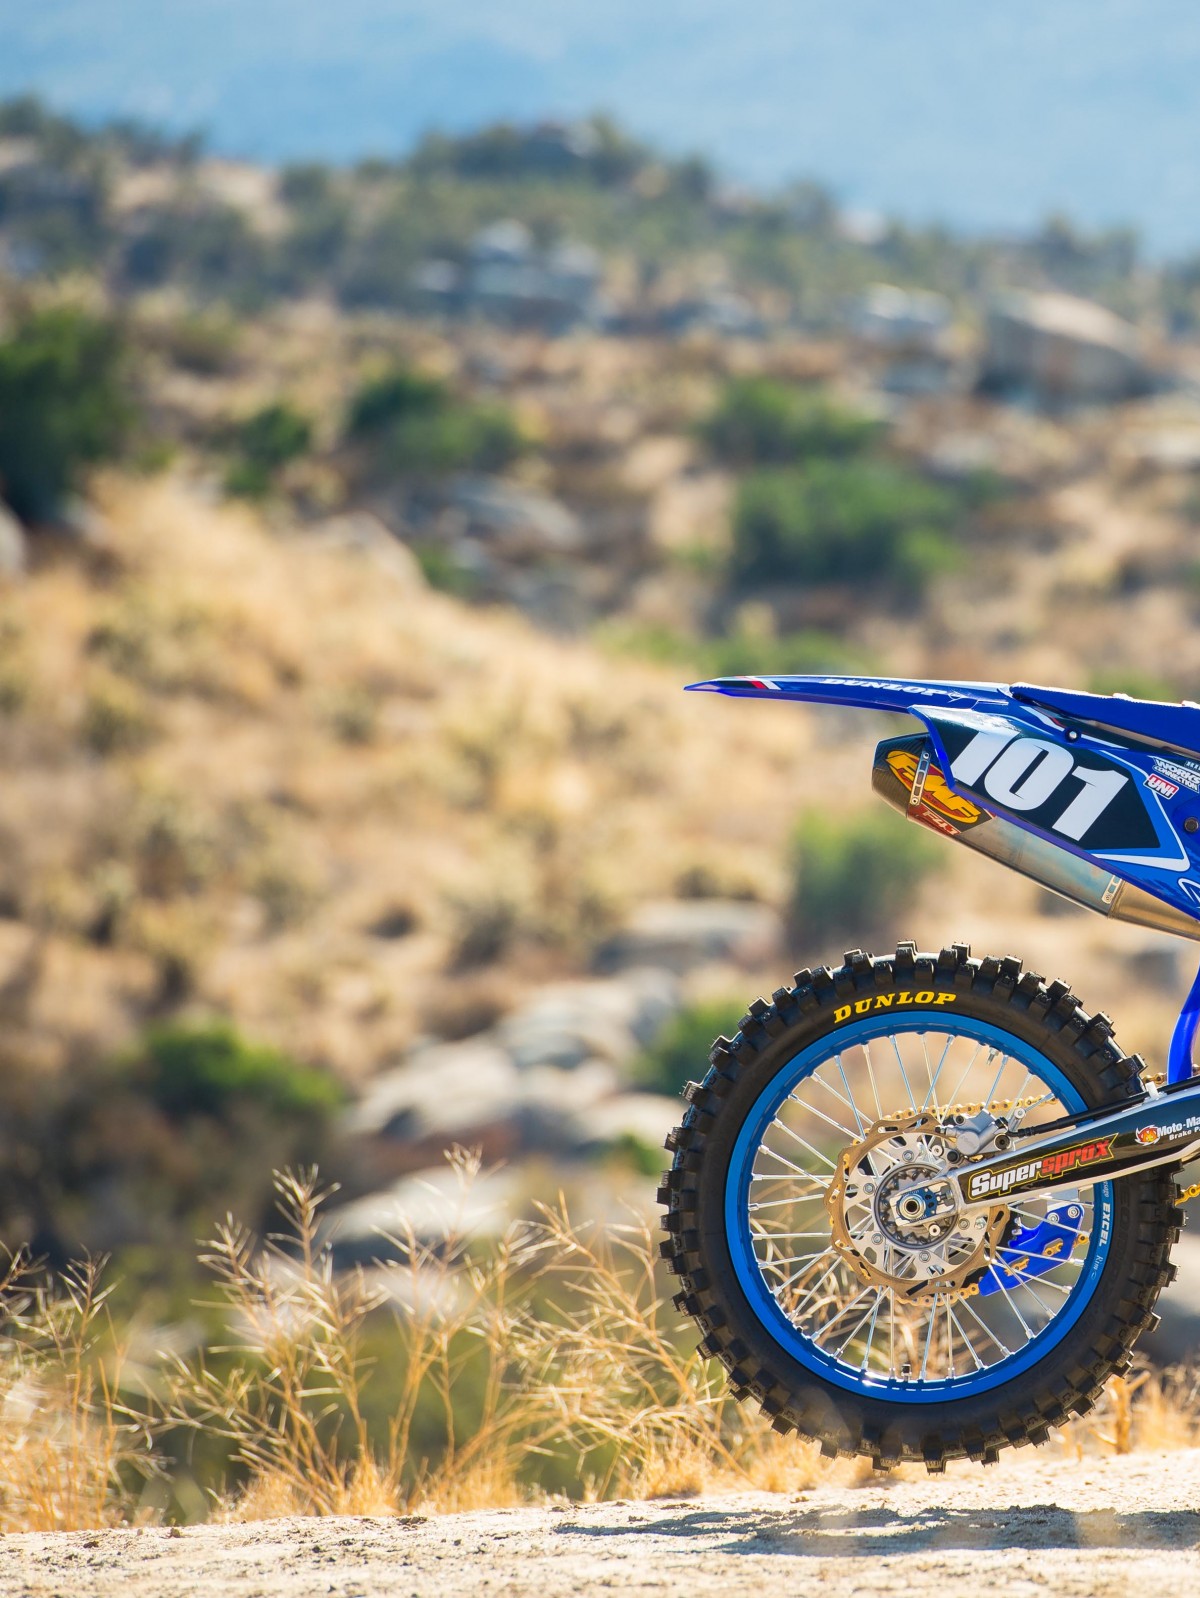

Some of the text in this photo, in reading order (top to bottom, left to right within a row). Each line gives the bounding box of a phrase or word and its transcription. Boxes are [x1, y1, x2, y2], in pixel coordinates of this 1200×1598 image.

[819, 678, 950, 697] DUNLOP
[949, 729, 1129, 842] 101
[1147, 774, 1177, 797] UNI
[833, 990, 957, 1024] DUNLOP
[1169, 1129, 1192, 1141] Brake
[970, 1139, 1111, 1198] Supersprox
[1099, 1202, 1111, 1247] EXCEL
